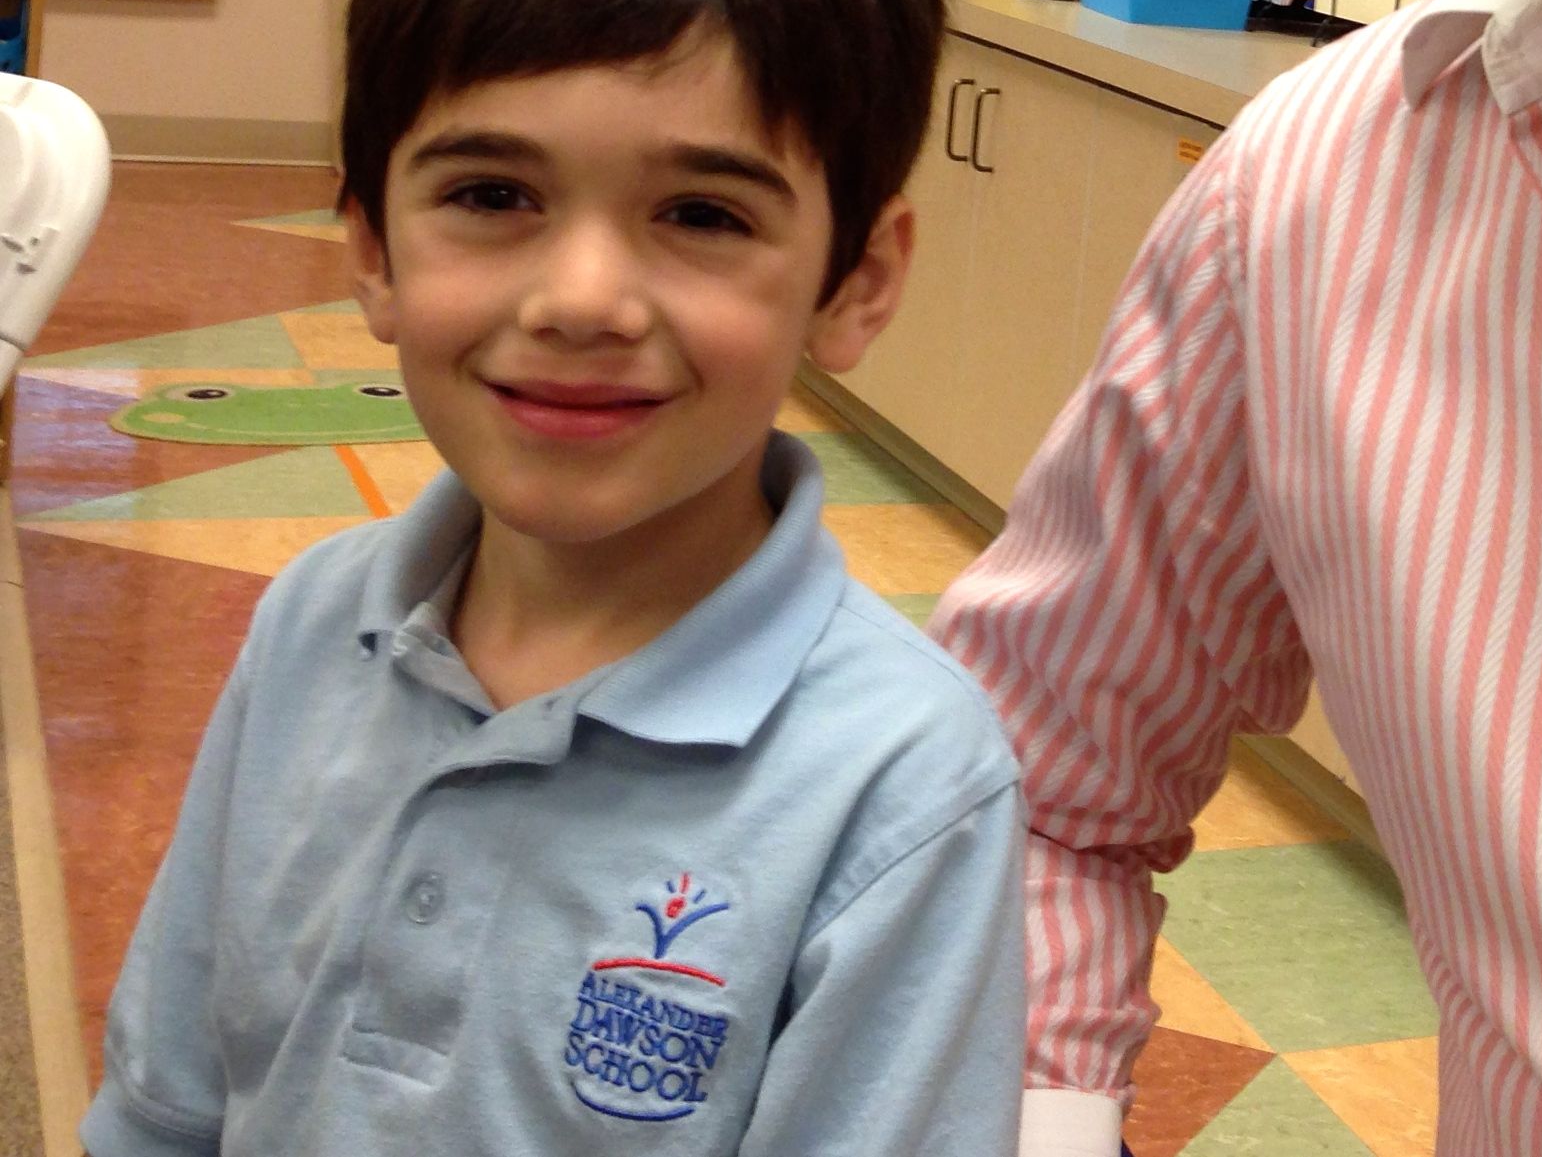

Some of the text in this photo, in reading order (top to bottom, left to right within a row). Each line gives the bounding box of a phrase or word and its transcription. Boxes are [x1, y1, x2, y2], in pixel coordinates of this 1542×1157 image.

[570, 996, 728, 1070] DAWSON
[578, 971, 729, 1038] ALEXANDER
[564, 1031, 708, 1102] SCHOOL
